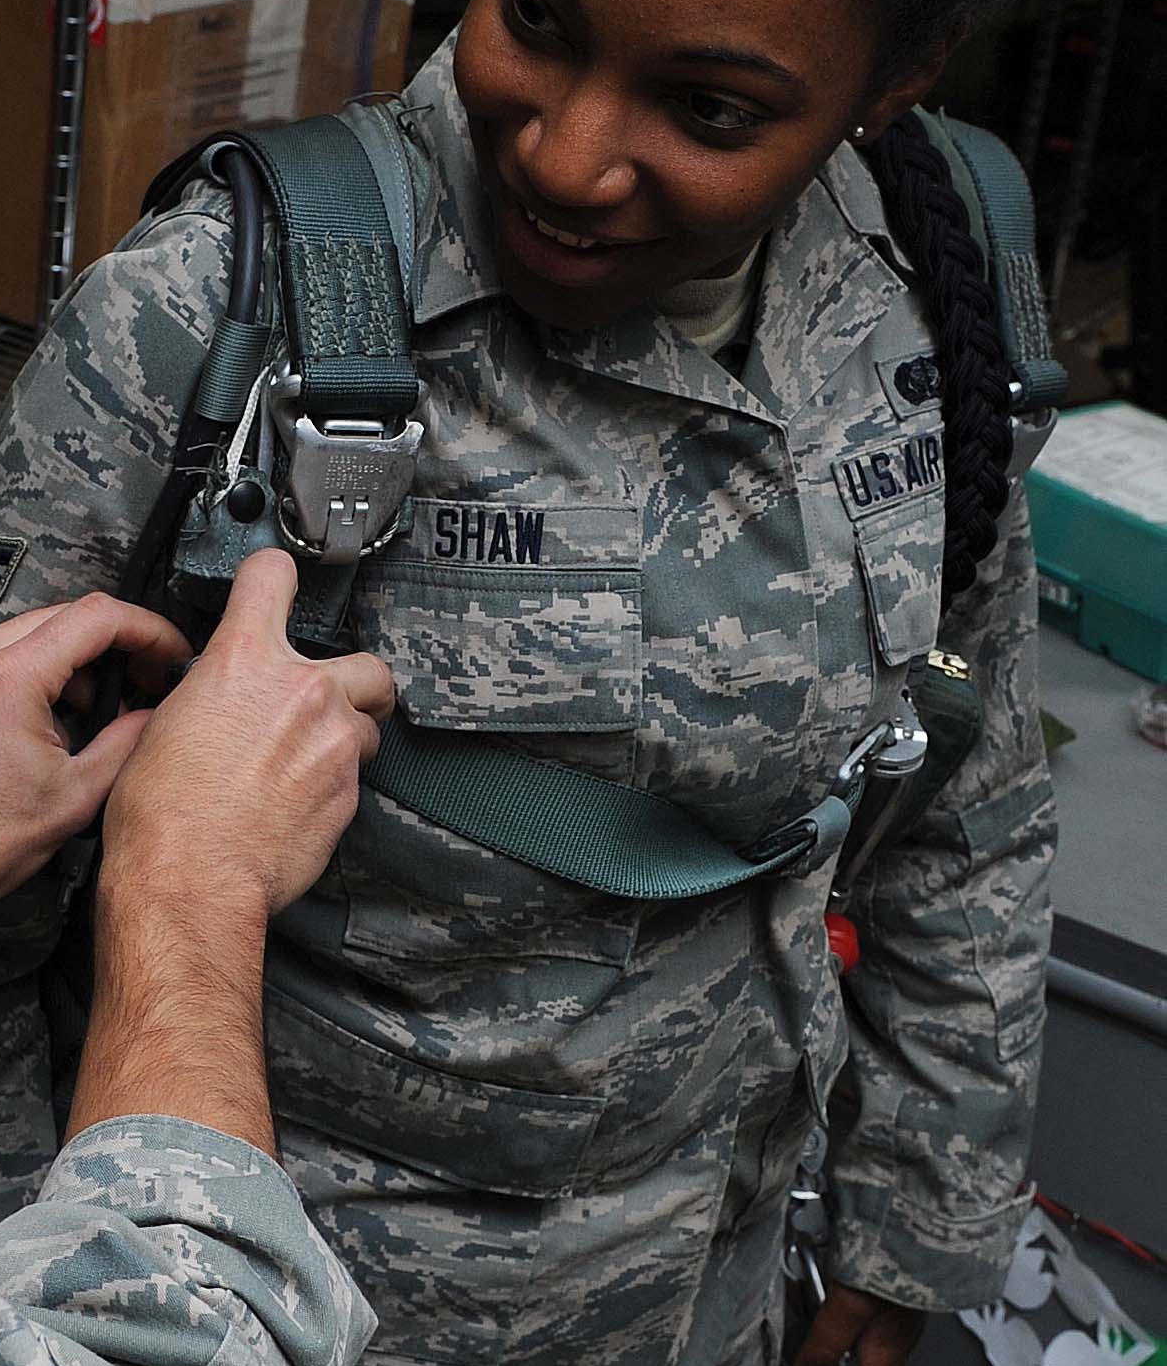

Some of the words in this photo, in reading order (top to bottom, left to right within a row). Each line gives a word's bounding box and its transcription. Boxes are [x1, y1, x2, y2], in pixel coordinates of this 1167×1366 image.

[842, 452, 904, 507] U.S.
[903, 435, 942, 492] AIR
[434, 508, 545, 565] SHAW
